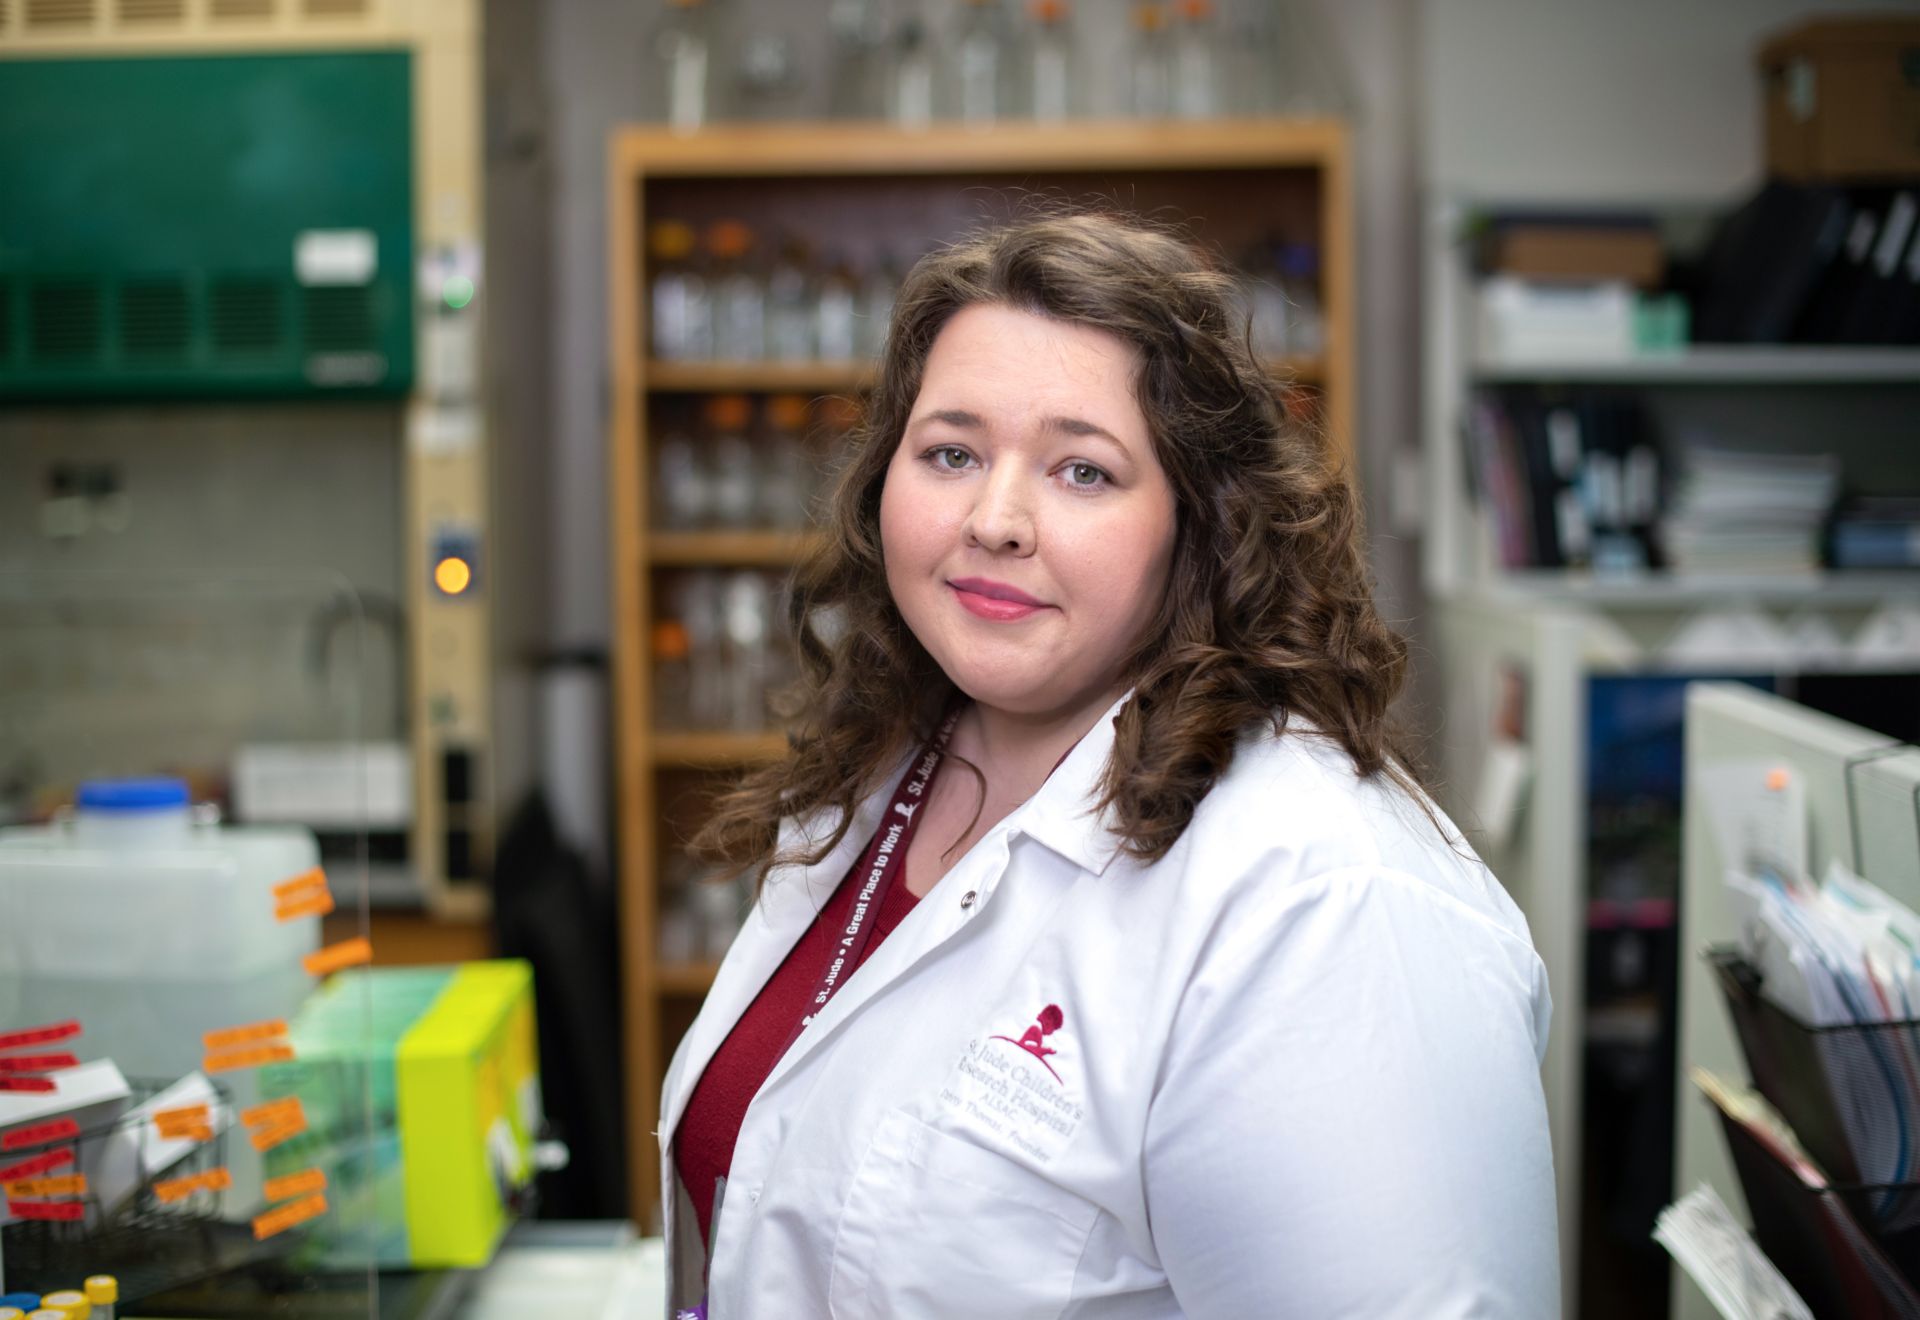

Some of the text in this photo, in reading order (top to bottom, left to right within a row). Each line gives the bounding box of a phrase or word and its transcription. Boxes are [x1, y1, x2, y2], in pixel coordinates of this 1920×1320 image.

[907, 781, 925, 797] St.
[916, 751, 939, 780] Jude
[815, 824, 904, 1003] St. Jude A Great Place to Work
[973, 1044, 1010, 1072] Jude
[1010, 1065, 1084, 1120] Children's
[979, 1093, 1019, 1120] ALSAC
[1010, 1087, 1077, 1137] Hospital
